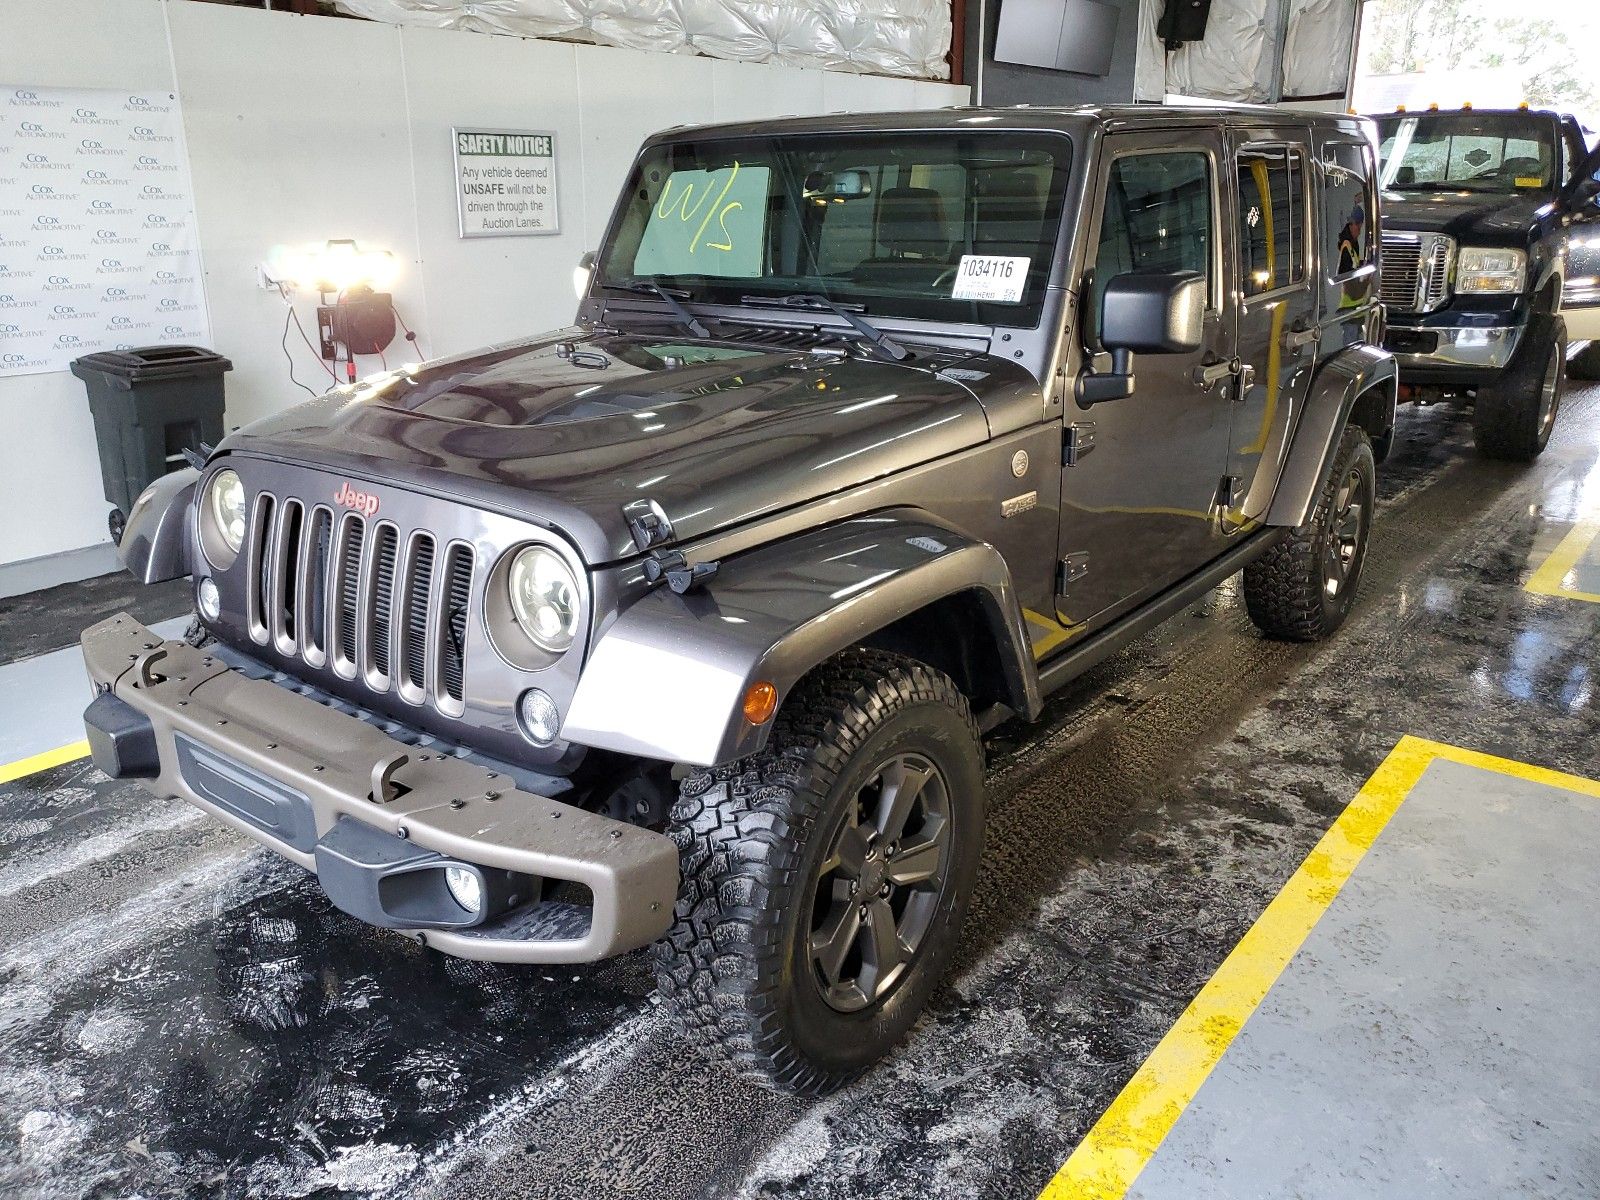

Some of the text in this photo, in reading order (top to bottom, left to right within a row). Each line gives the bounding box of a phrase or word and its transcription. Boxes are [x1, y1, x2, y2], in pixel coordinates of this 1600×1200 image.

[459, 133, 551, 155] SAFETY NOTICE
[462, 166, 547, 180] Any vehicle deemed
[463, 183, 546, 194] UNSAFE will not be
[468, 201, 543, 213] driven through the
[482, 217, 513, 229] Auction
[963, 259, 1014, 277] 1034116
[334, 481, 380, 518] Jeep
